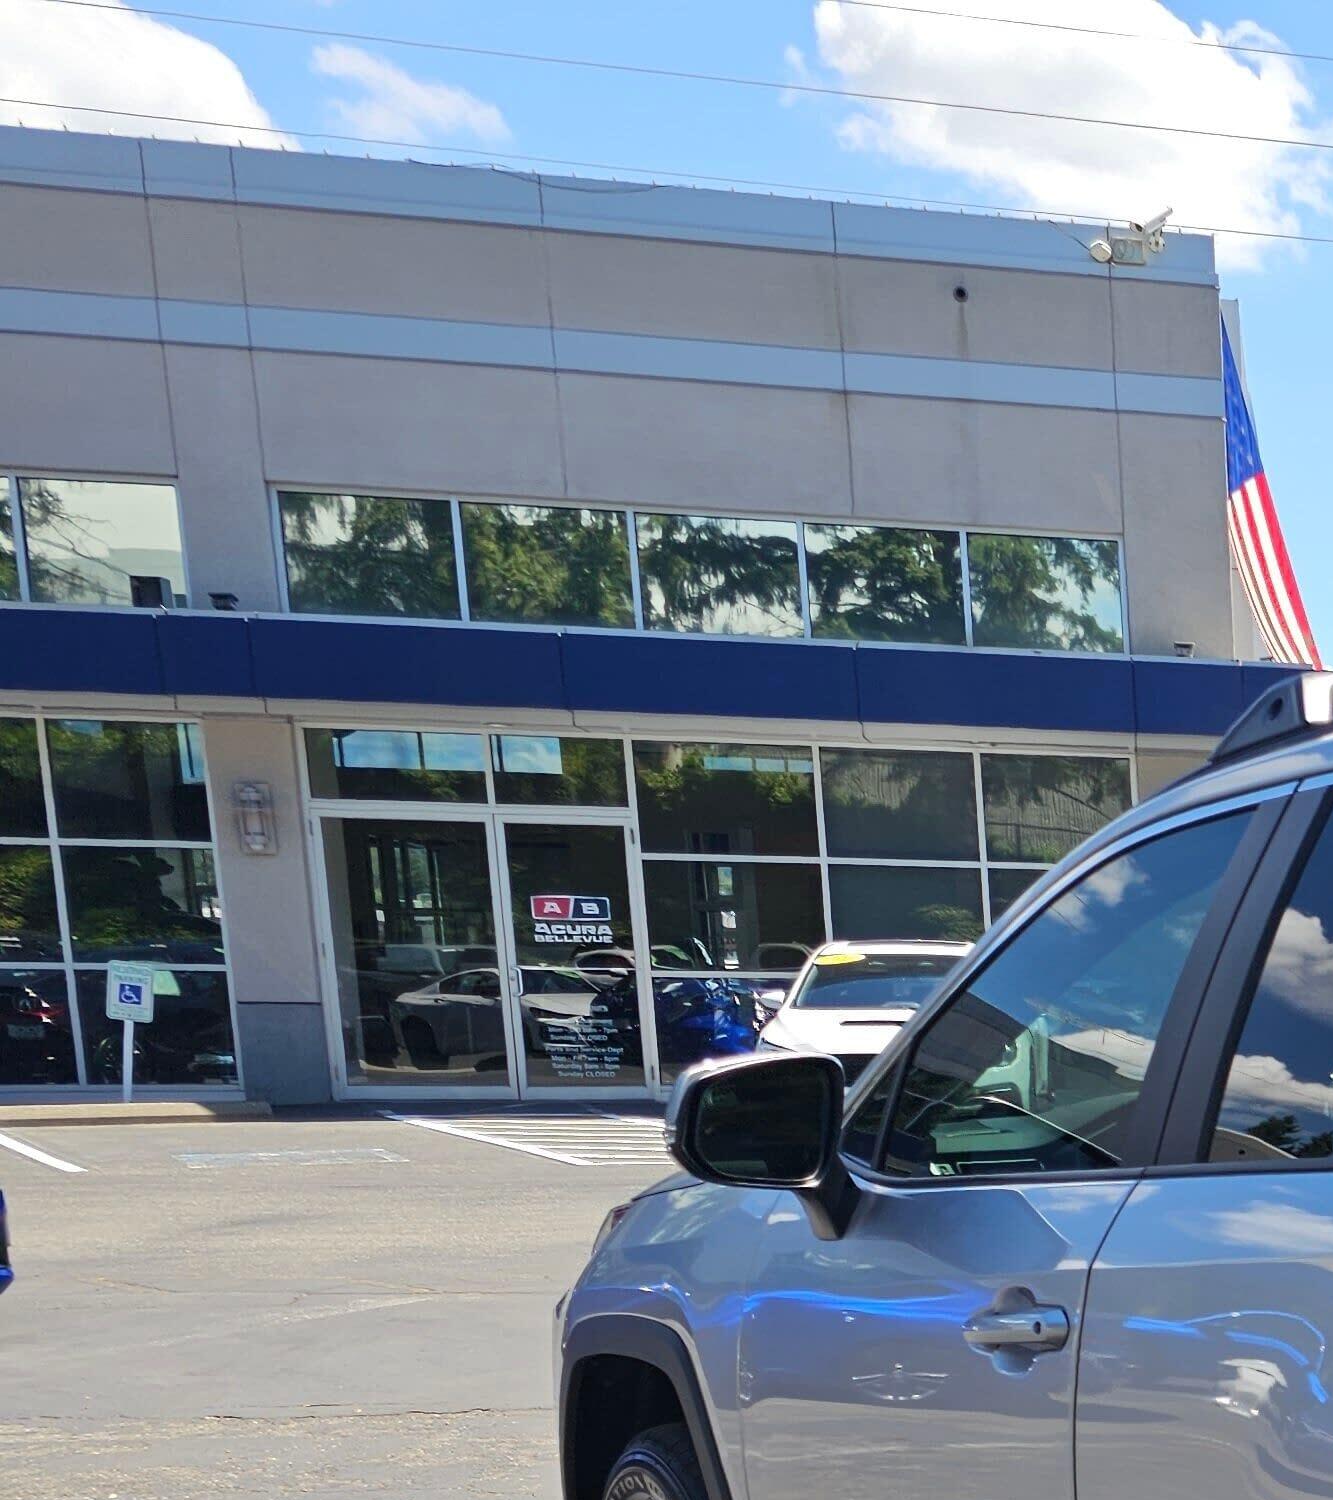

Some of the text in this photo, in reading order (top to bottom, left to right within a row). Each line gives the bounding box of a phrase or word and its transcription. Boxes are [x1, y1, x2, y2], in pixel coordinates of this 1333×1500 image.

[543, 901, 600, 915] A B
[534, 922, 613, 935] ACURA
[534, 934, 614, 944] BELLEVUE
